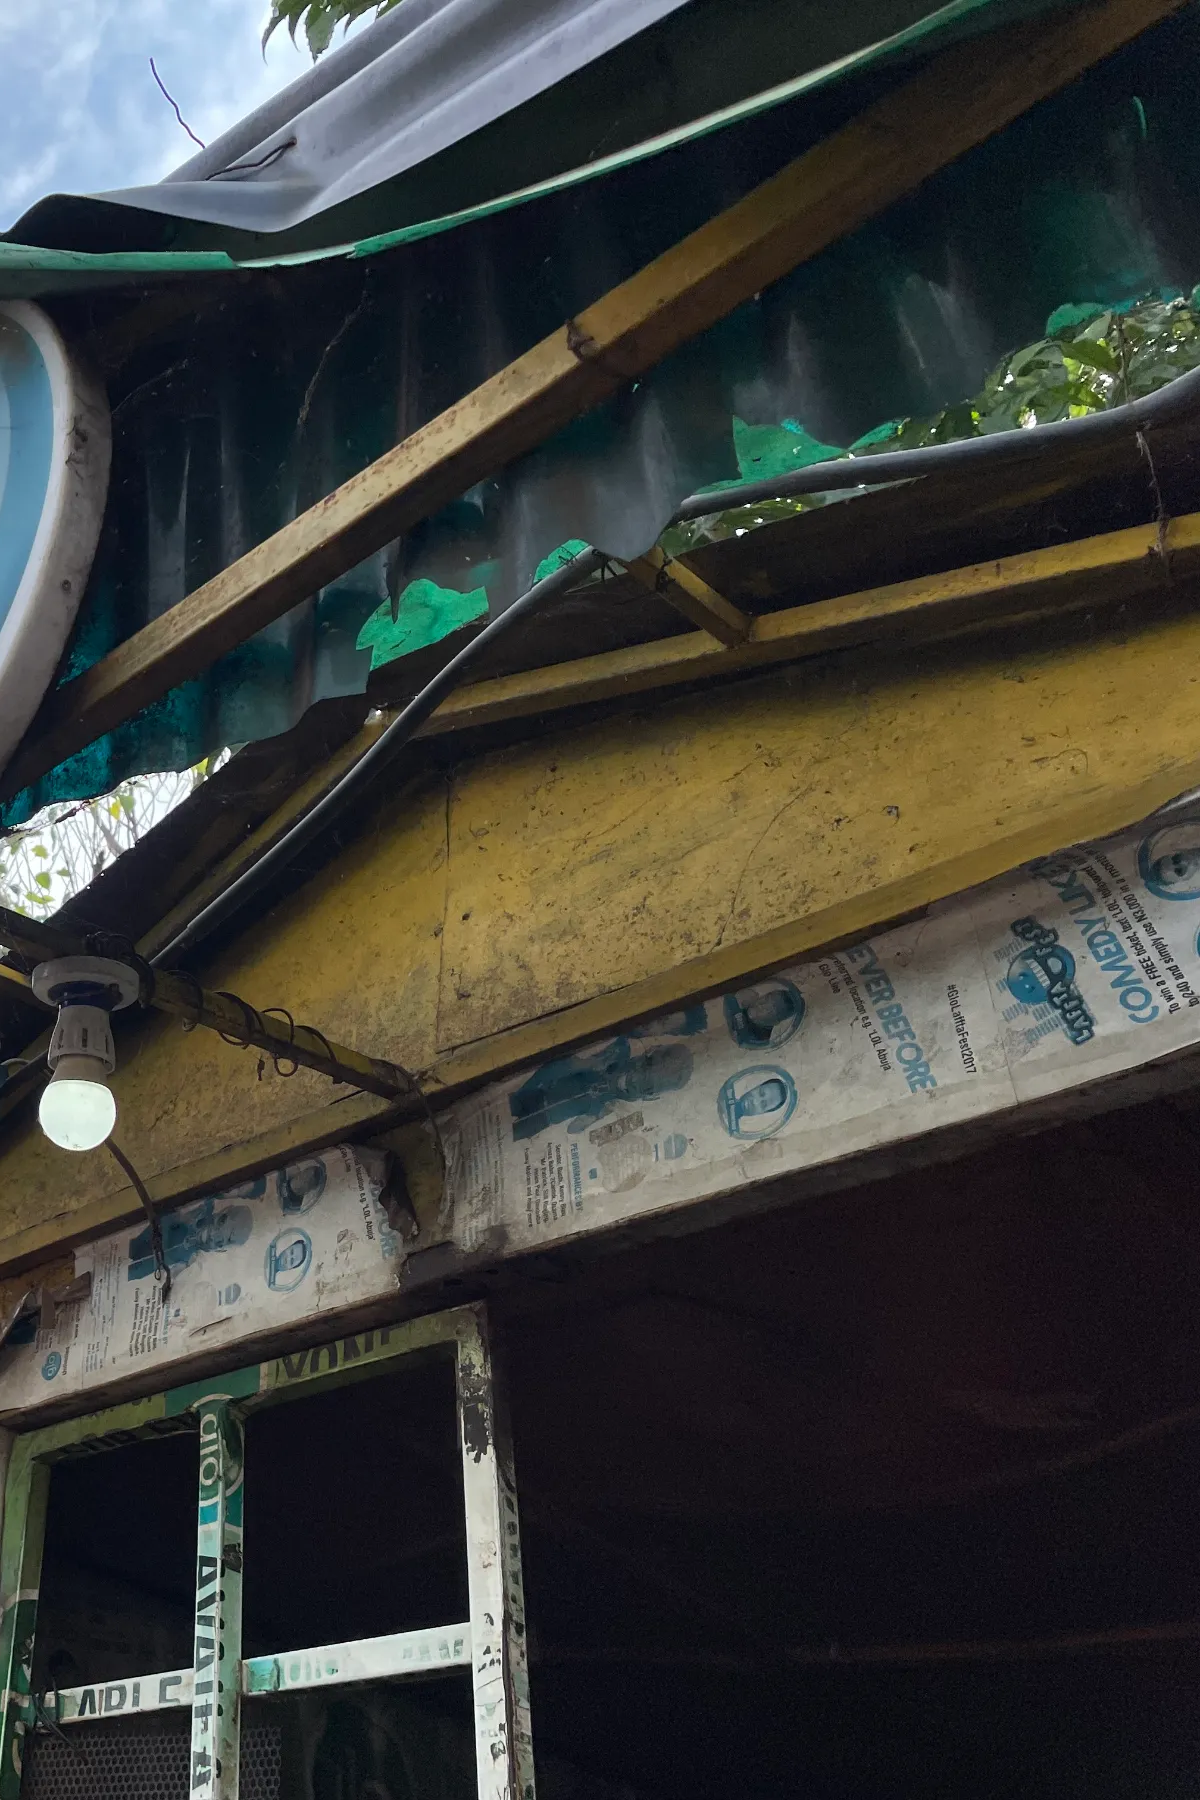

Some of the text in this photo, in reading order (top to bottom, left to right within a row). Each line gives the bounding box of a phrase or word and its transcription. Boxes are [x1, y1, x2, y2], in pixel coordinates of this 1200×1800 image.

[1073, 917, 1159, 1024] COMEDY
[1139, 954, 1162, 982] FREE
[875, 1002, 936, 1095] BEFORE
[1049, 979, 1093, 1045] LAFFTA
